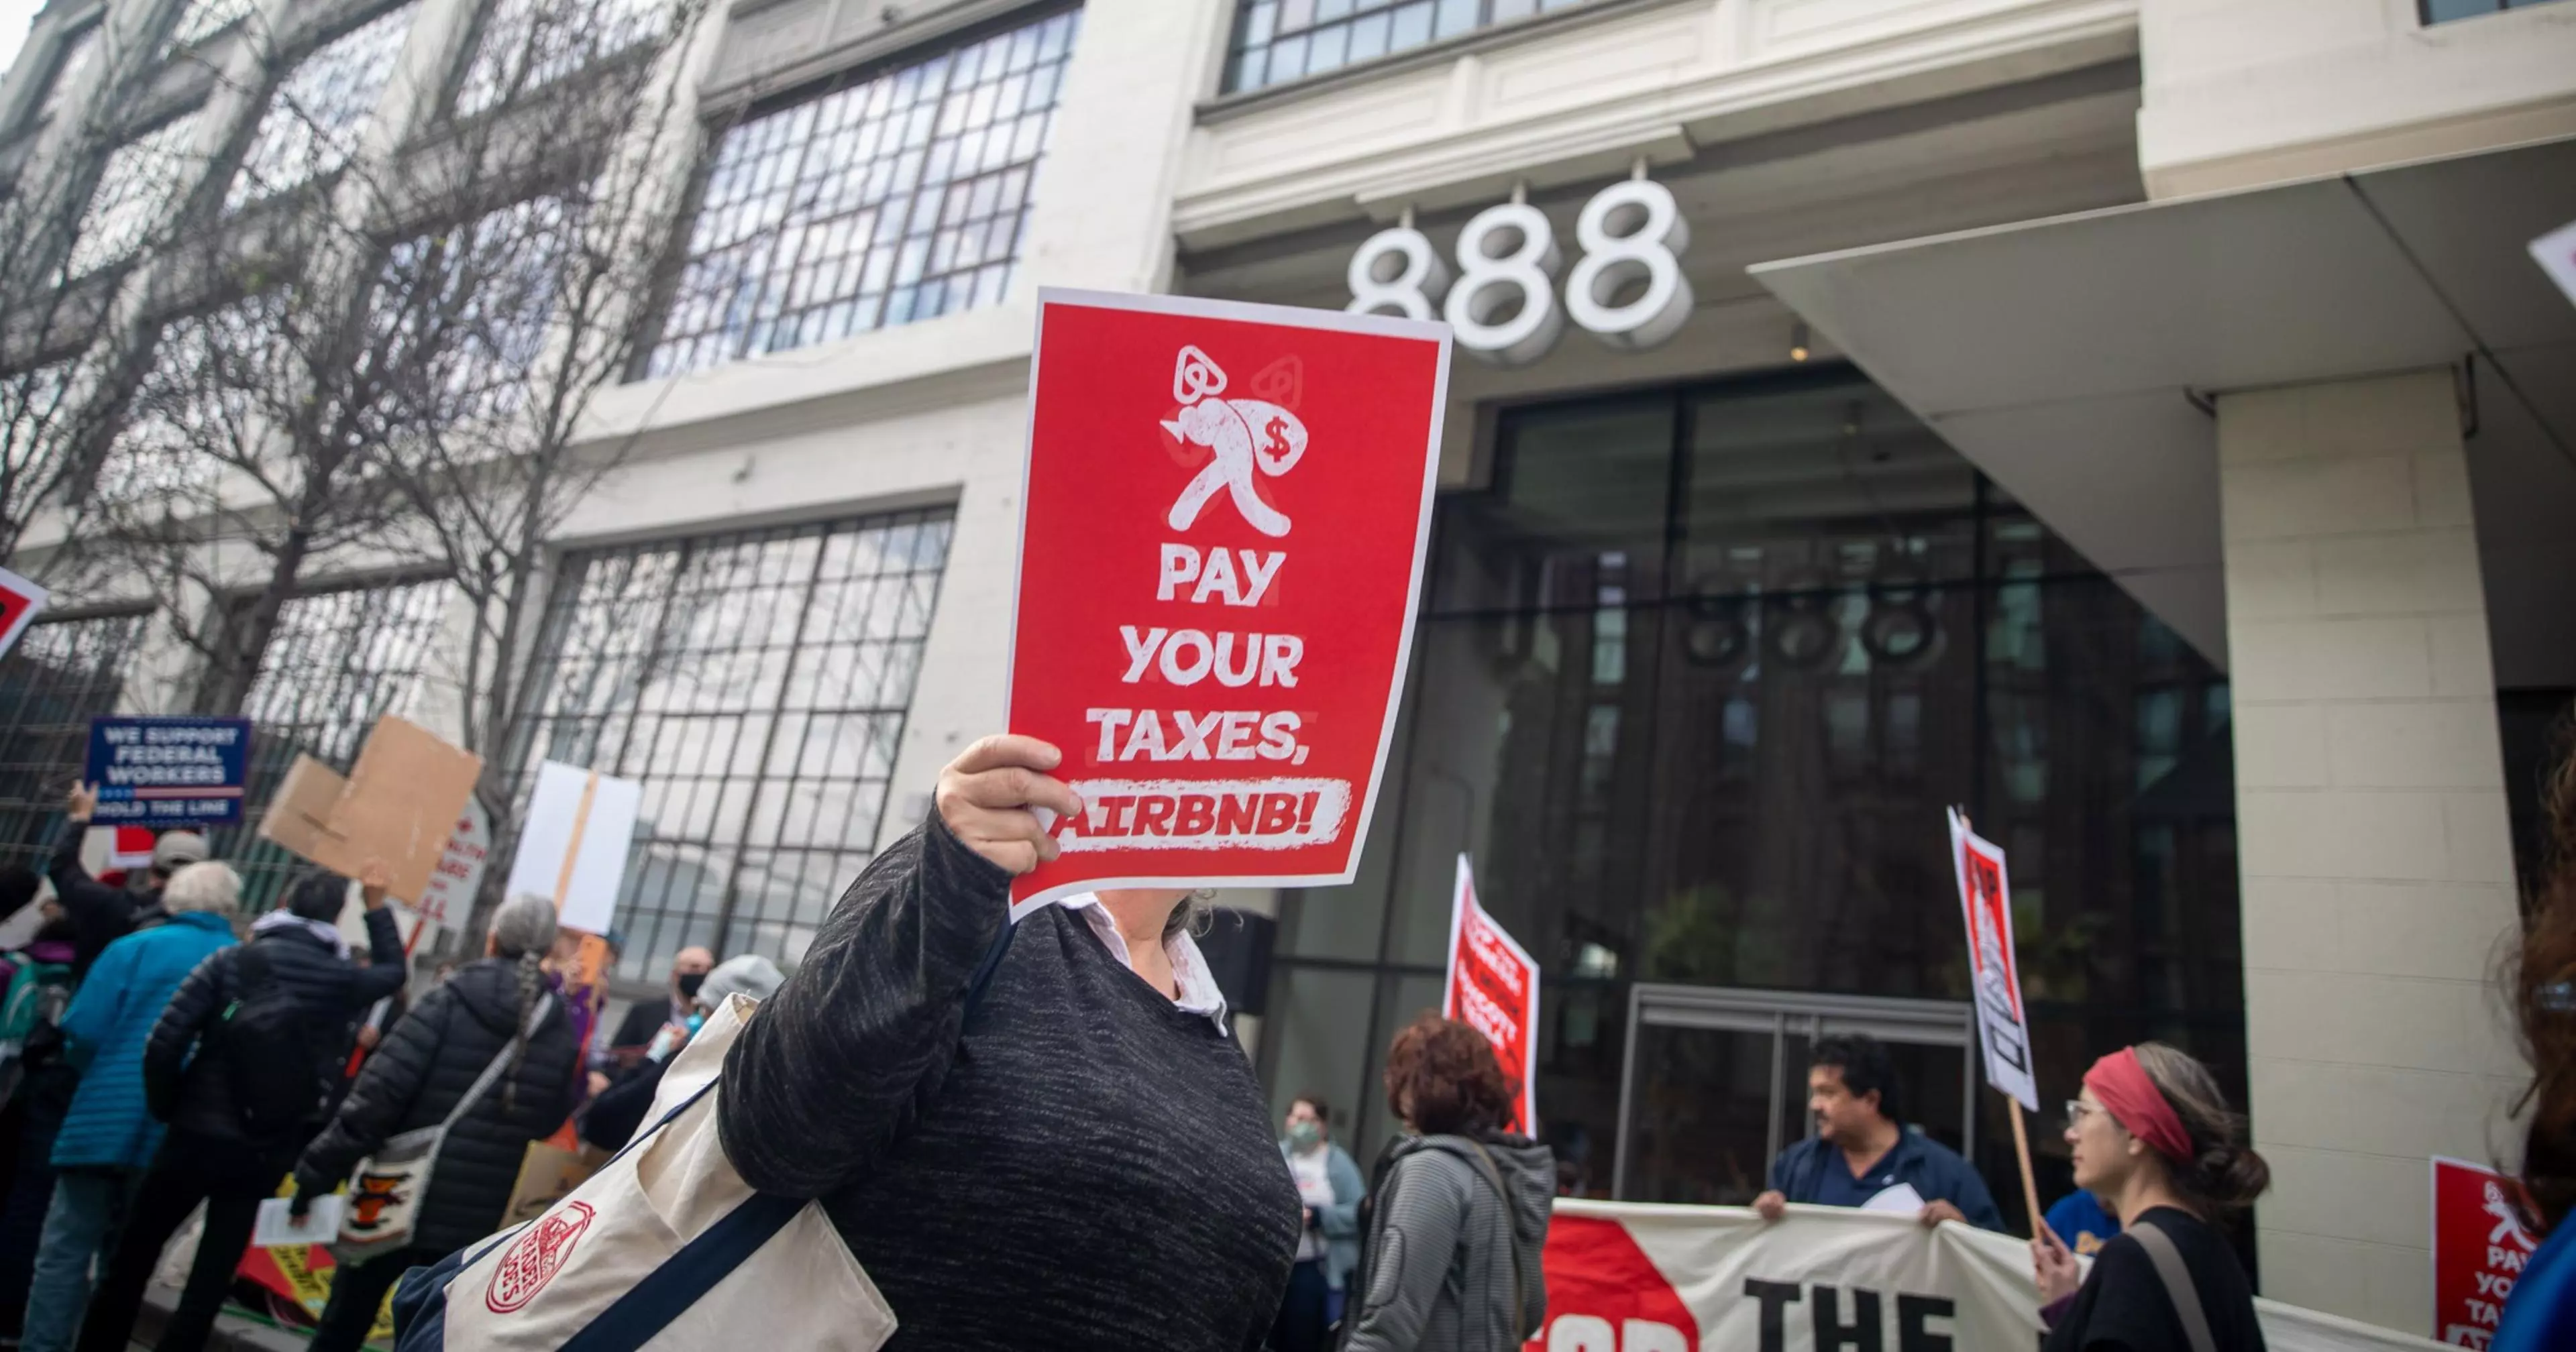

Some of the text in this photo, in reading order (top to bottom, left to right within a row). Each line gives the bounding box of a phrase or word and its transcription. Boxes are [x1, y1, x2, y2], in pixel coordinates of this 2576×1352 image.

[1344, 179, 1688, 357] 888
[1263, 416, 1291, 463] $
[1157, 543, 1287, 608] PAY
[1119, 625, 1304, 689] YOUR
[103, 726, 239, 745] WE SUPPORT
[115, 745, 223, 765] FEDERAL
[1085, 708, 1310, 766] TAXES,
[106, 765, 226, 785] WORKERS
[95, 799, 229, 817] HOLD THE LINE
[1051, 791, 1321, 838] AIRBNB!
[502, 1252, 521, 1302] JOE'S
[521, 1229, 539, 1296] TRADER
[2474, 1271, 2513, 1300] YO
[1743, 1278, 1955, 1352] THE
